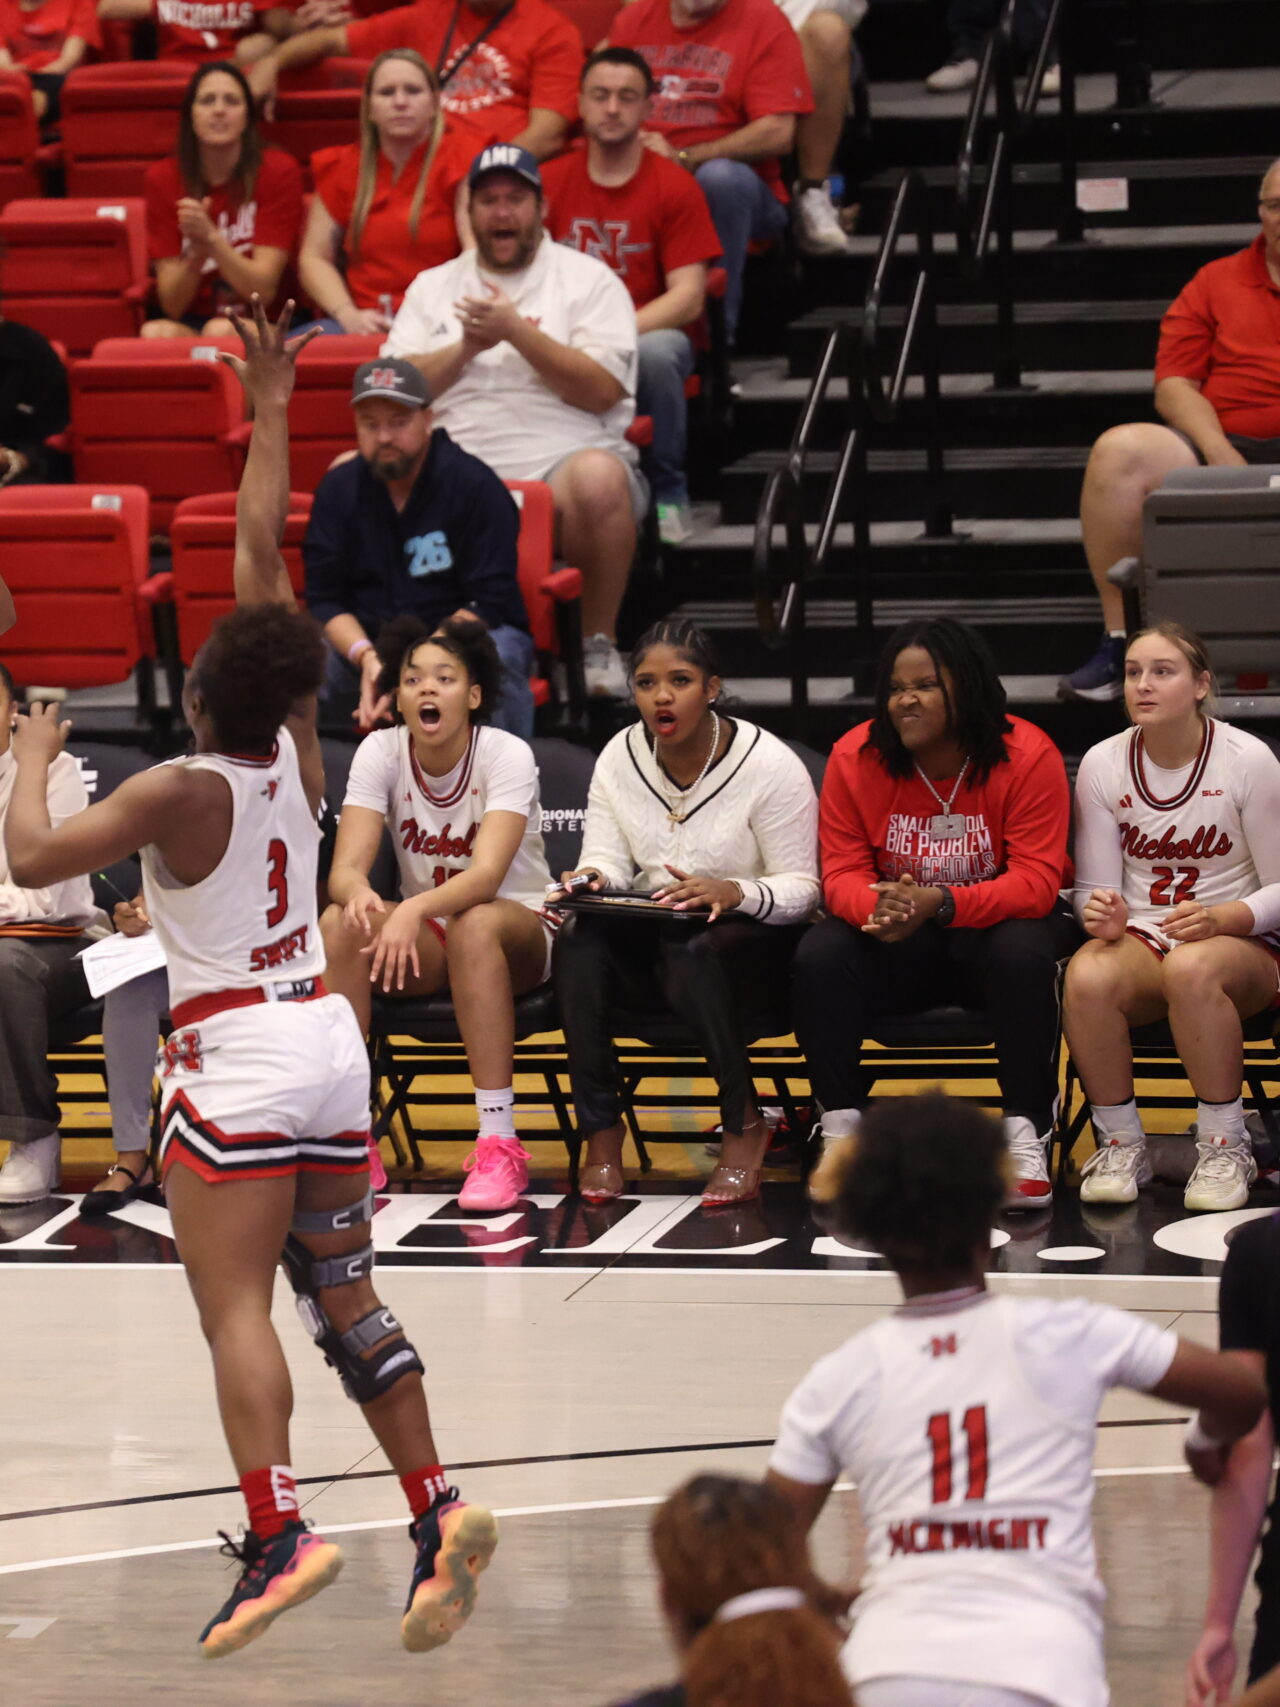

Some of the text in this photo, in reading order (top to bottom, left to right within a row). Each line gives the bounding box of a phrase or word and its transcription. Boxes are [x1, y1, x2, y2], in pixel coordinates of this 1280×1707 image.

[886, 829, 993, 857] BIG PROBLEM
[1119, 822, 1234, 860] Nicholls
[266, 838, 289, 929] 3
[1149, 866, 1200, 906] 22
[249, 924, 309, 973] SWIFT
[926, 1404, 989, 1505] 11
[888, 1515, 1050, 1557] MCKNIGHT
